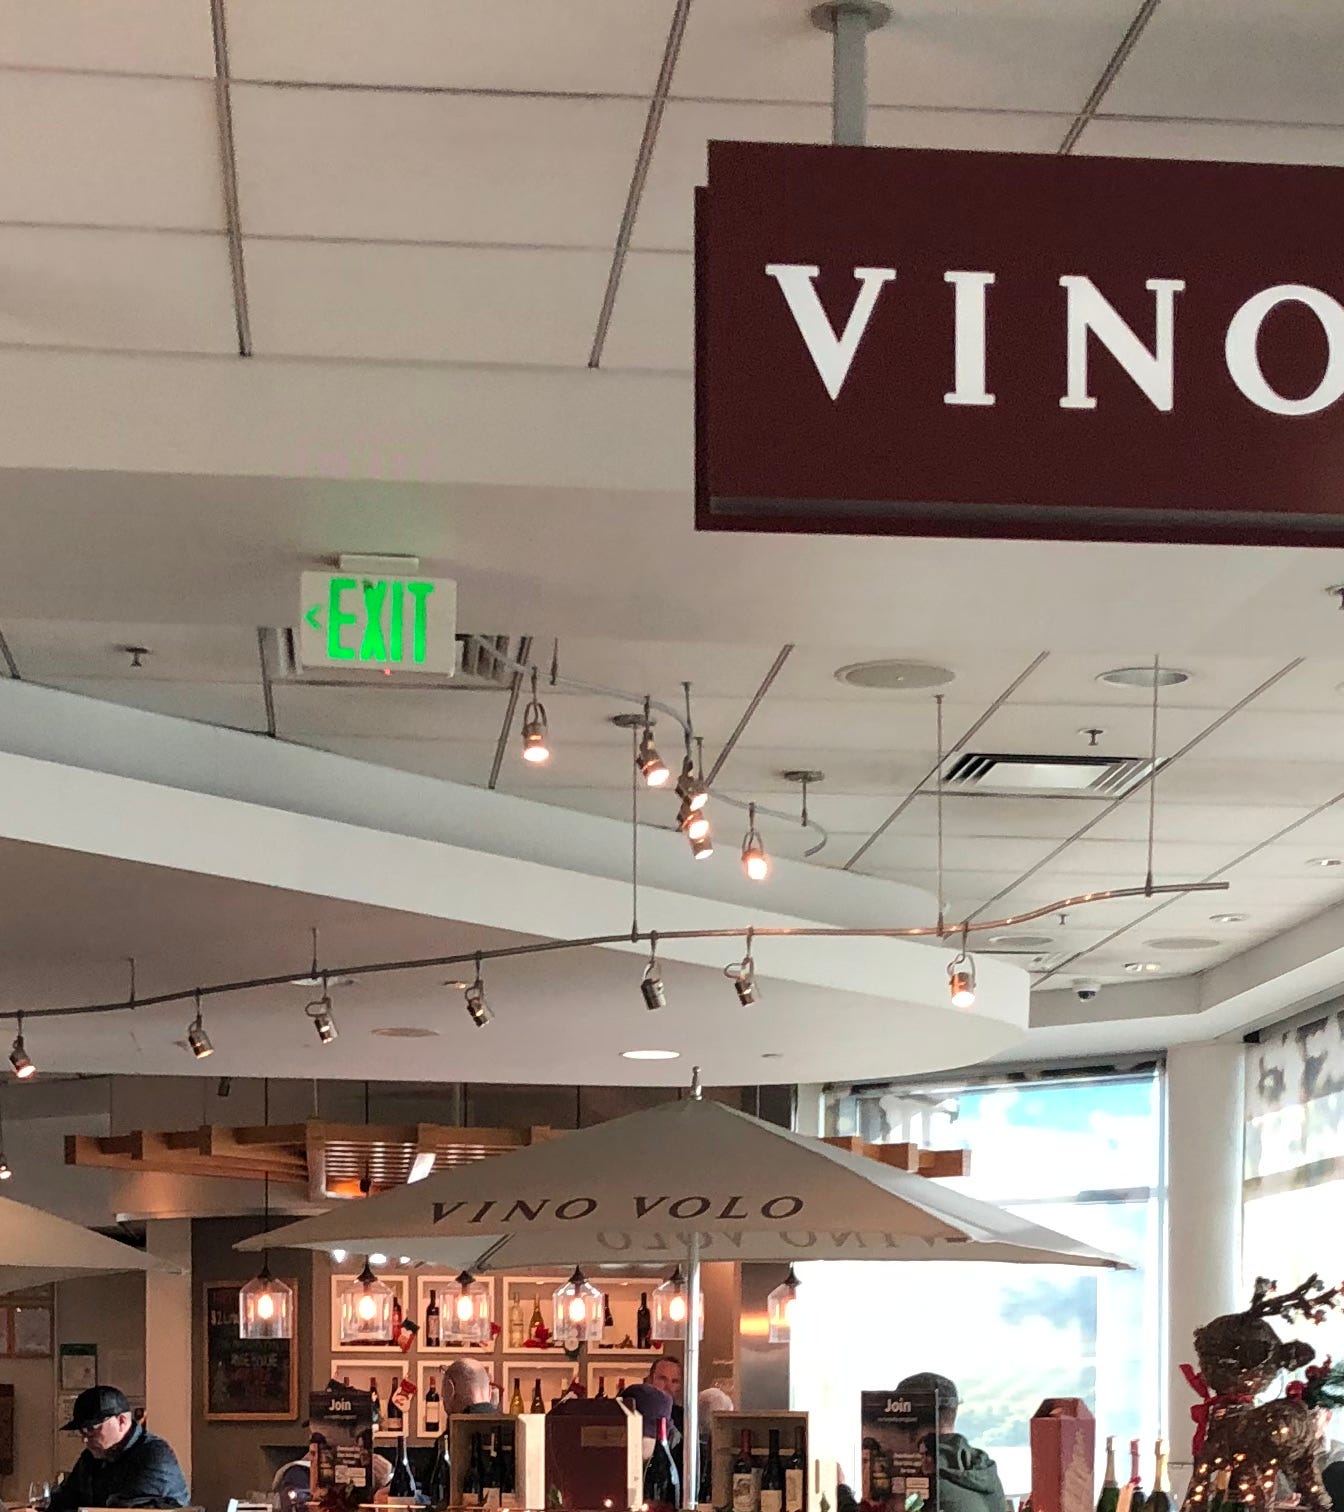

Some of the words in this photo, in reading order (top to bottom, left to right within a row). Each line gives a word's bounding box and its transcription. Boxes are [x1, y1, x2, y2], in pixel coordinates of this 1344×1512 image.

[327, 576, 434, 663] EXIT
[430, 1197, 598, 1225] VINO
[632, 1195, 804, 1220] VOLO
[328, 1398, 352, 1412] Join
[884, 1397, 912, 1413] Join
